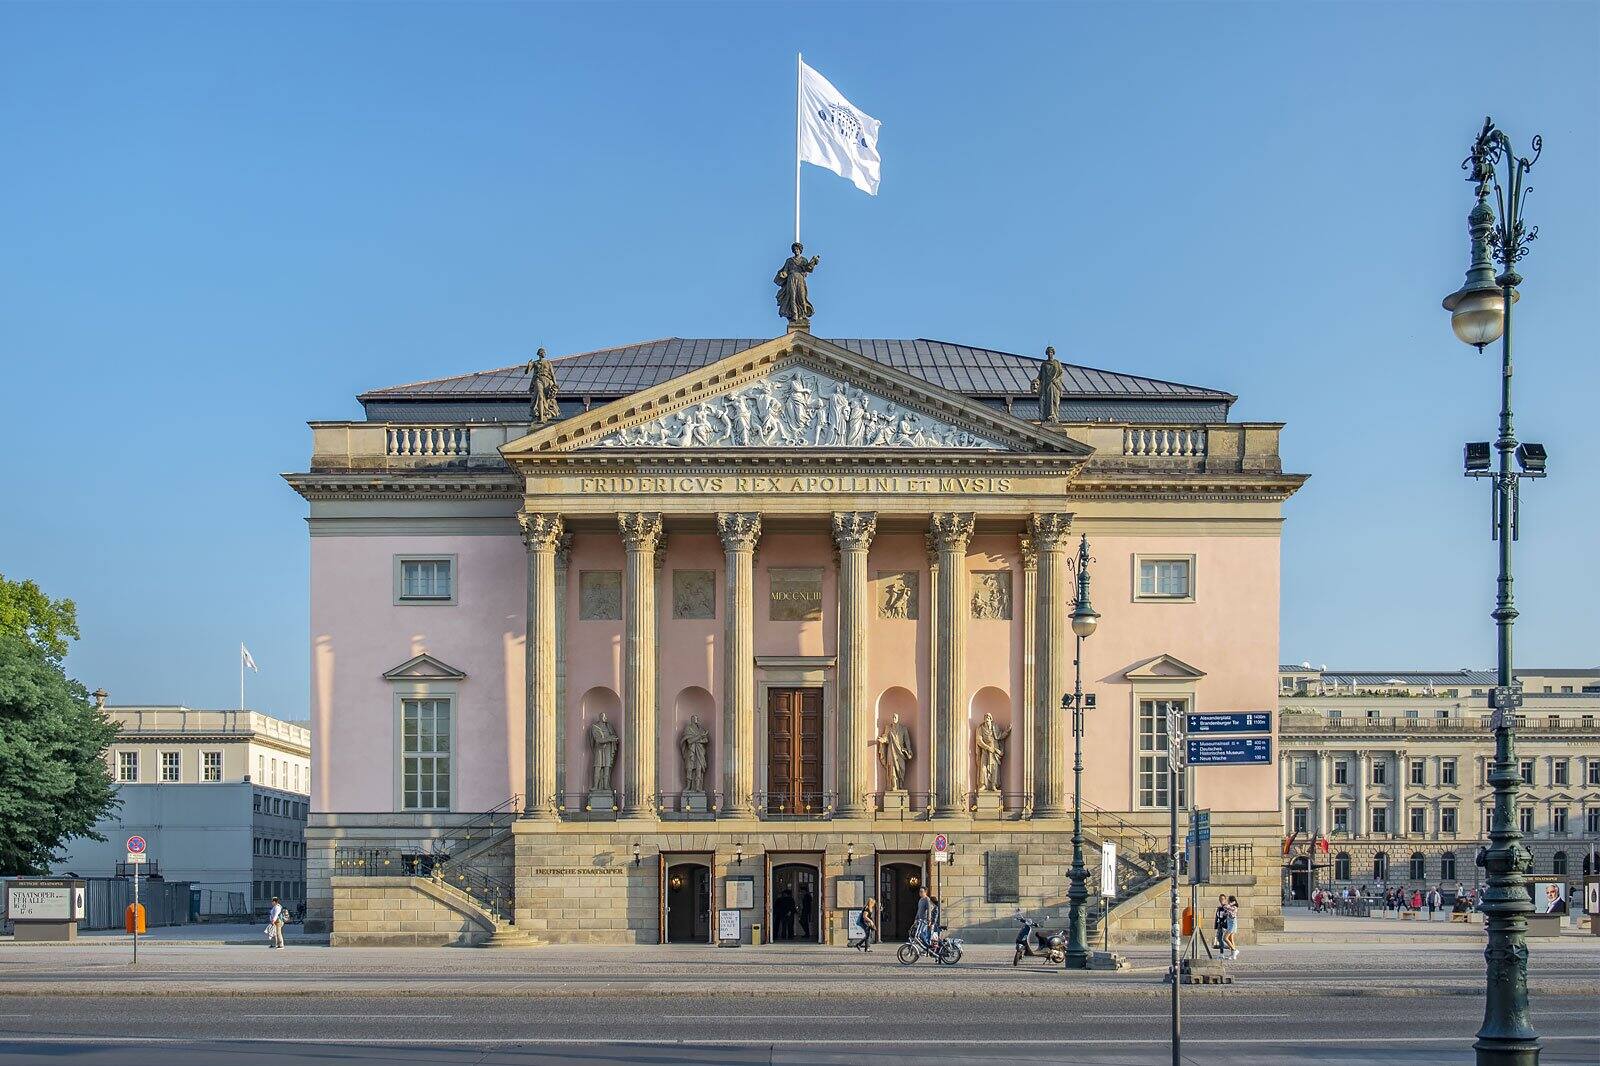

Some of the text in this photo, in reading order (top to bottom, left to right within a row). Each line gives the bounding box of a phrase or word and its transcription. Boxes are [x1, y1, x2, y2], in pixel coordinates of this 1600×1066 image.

[580, 478, 1011, 493] FRIDERICVS REX APOLLINI ET MVSIS
